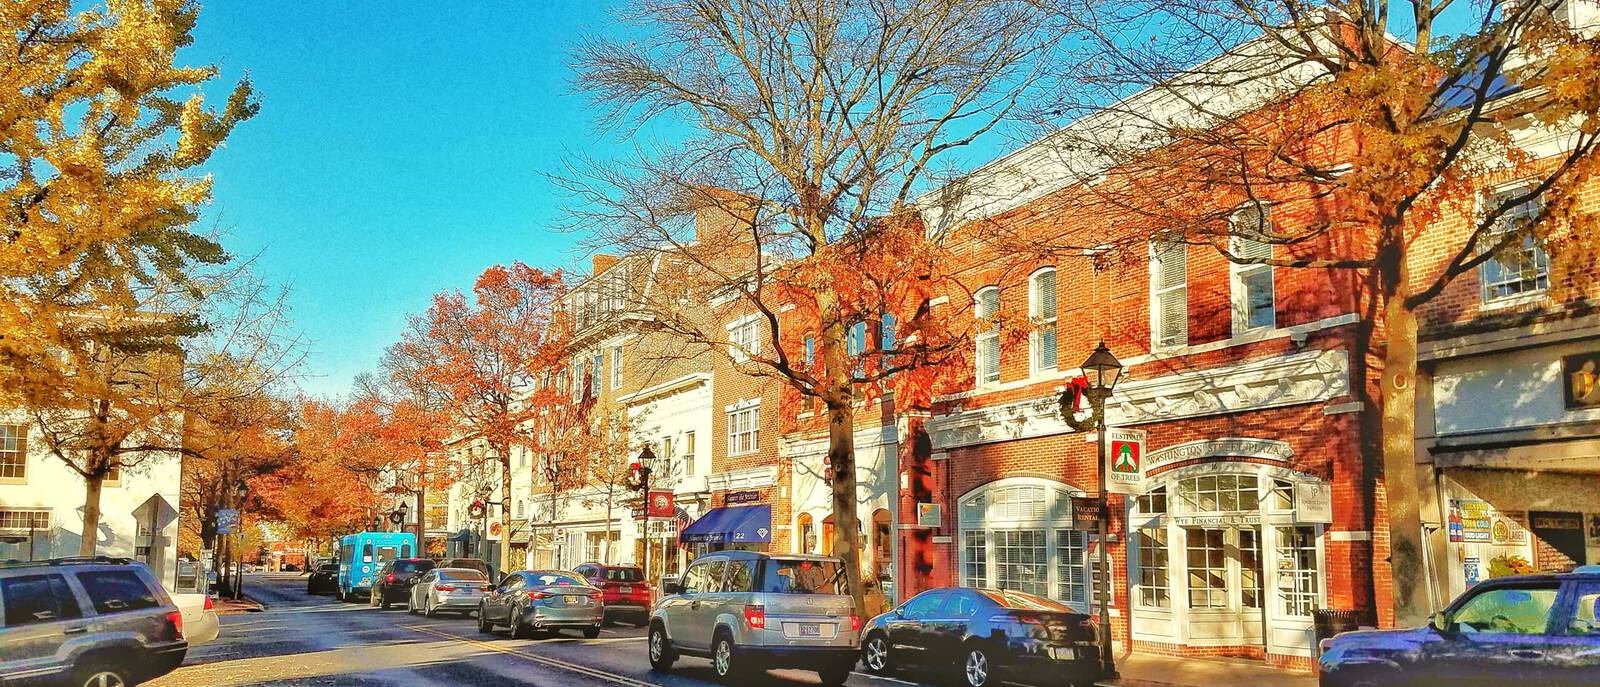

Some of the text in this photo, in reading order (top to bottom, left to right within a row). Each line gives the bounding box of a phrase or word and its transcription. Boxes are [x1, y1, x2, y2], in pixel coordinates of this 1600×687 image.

[1111, 432, 1143, 441] FESTIVAL
[1147, 445, 1203, 466] WASHINGTON
[1247, 443, 1280, 455] PLAZA
[1174, 516, 1189, 525] WYE
[1192, 515, 1227, 525] FINANCIAL
[1241, 515, 1261, 524] TRUST
